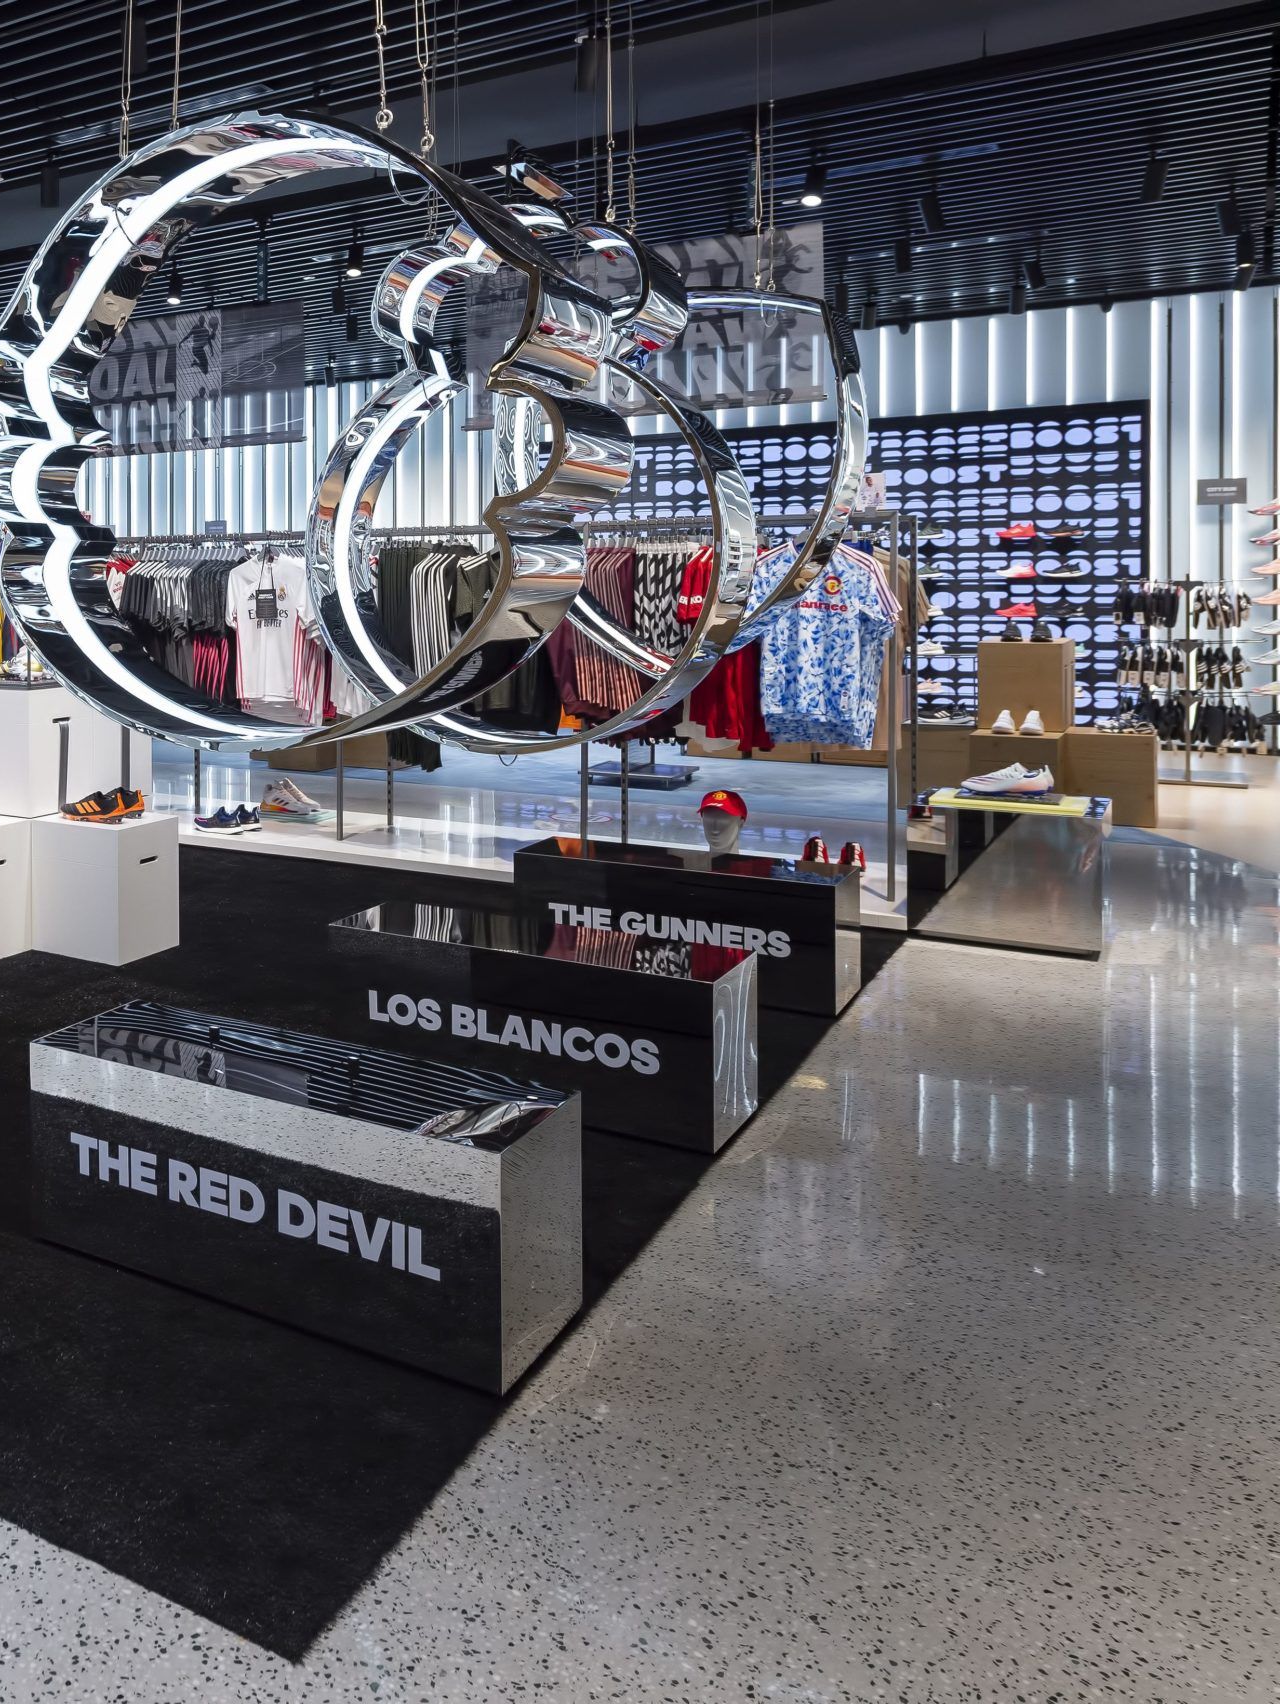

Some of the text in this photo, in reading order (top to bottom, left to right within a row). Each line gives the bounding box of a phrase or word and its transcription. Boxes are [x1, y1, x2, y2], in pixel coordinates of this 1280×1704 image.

[1010, 424, 1141, 449] BOOST
[881, 464, 1008, 487] BOOST
[1010, 490, 1141, 513] BOOST
[548, 902, 792, 958] THE GUNNERS
[369, 990, 660, 1075] LOS BLANCOS
[70, 1132, 441, 1281] THE RED DEVIL
